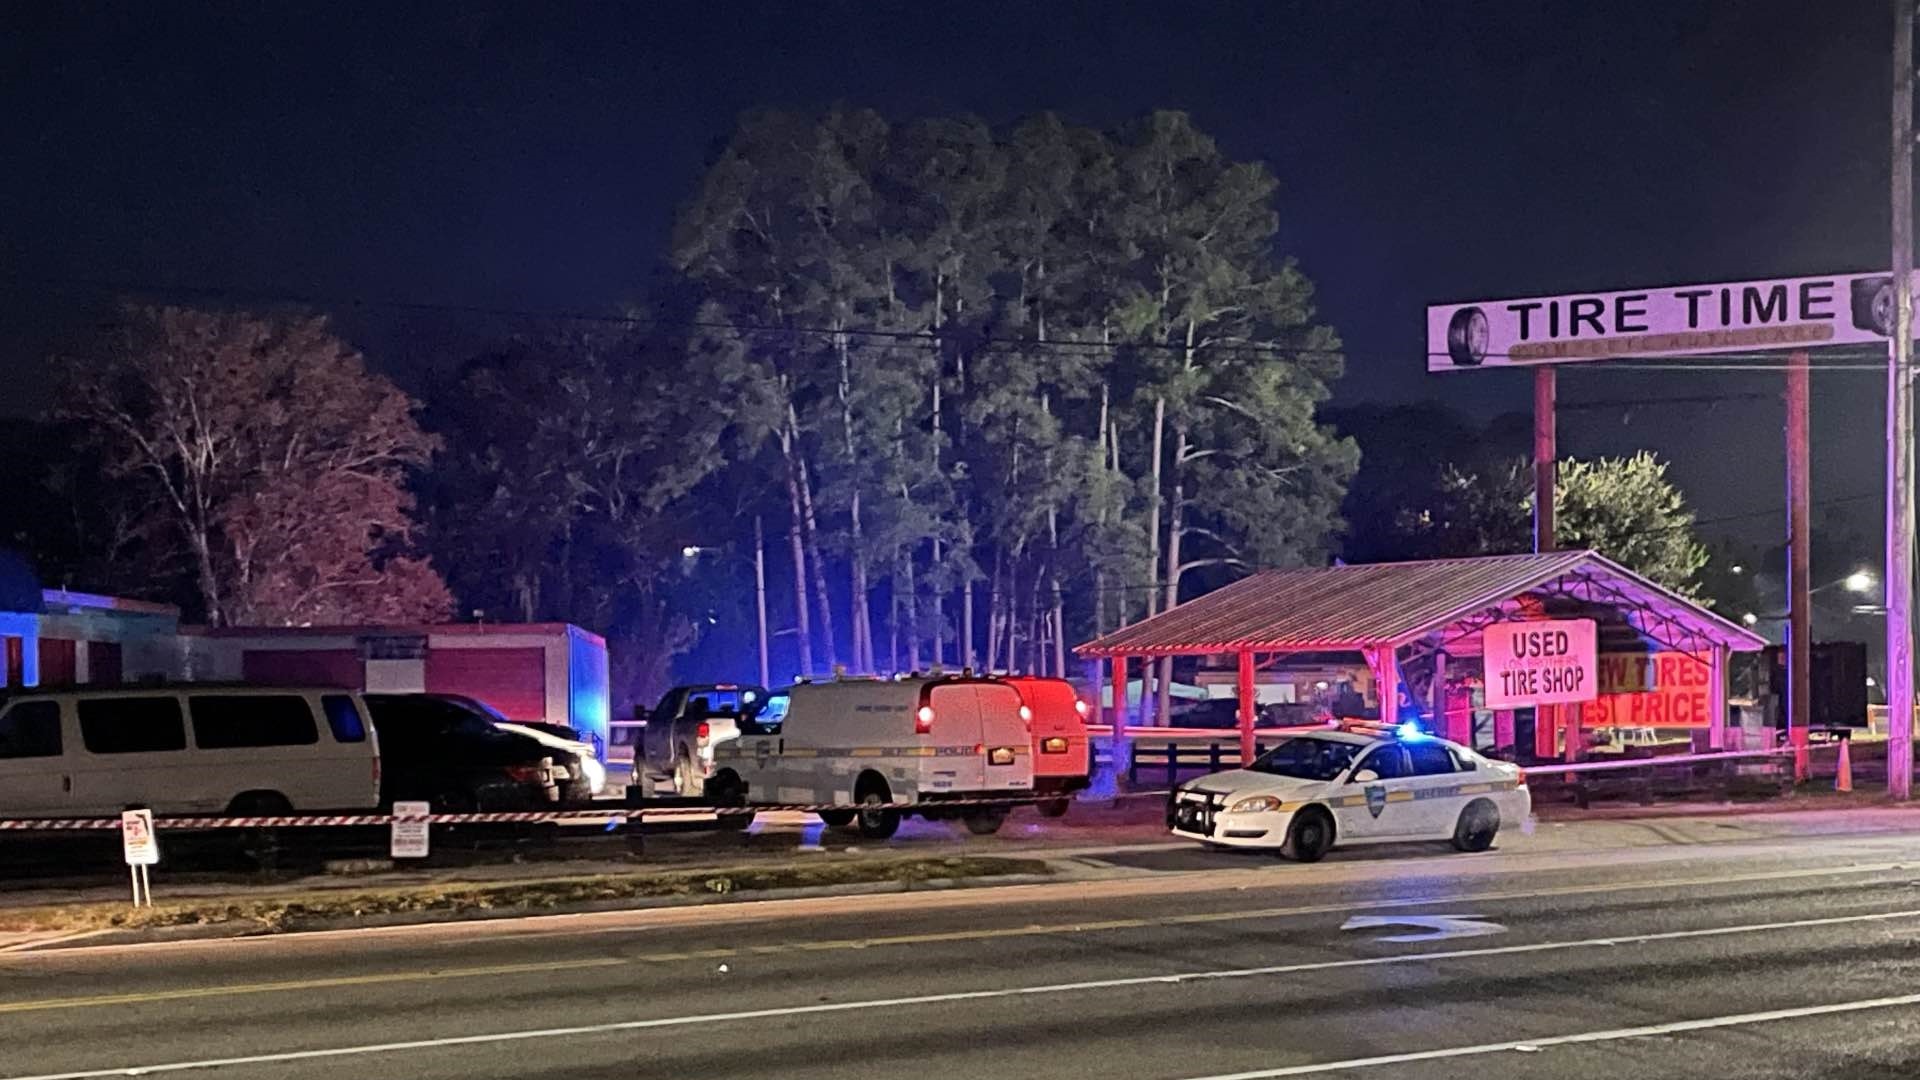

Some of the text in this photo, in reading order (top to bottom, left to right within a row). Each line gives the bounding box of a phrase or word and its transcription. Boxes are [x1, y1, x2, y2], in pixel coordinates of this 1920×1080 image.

[1507, 281, 1836, 340] TIRE TIME
[1510, 337, 1651, 357] COMETE
[1512, 631, 1569, 659] USED
[1500, 666, 1584, 697] TIRE SHOP
[1599, 656, 1709, 688] EW TIRES
[1583, 693, 1706, 723] EST PRICE
[936, 746, 976, 757] POLIC
